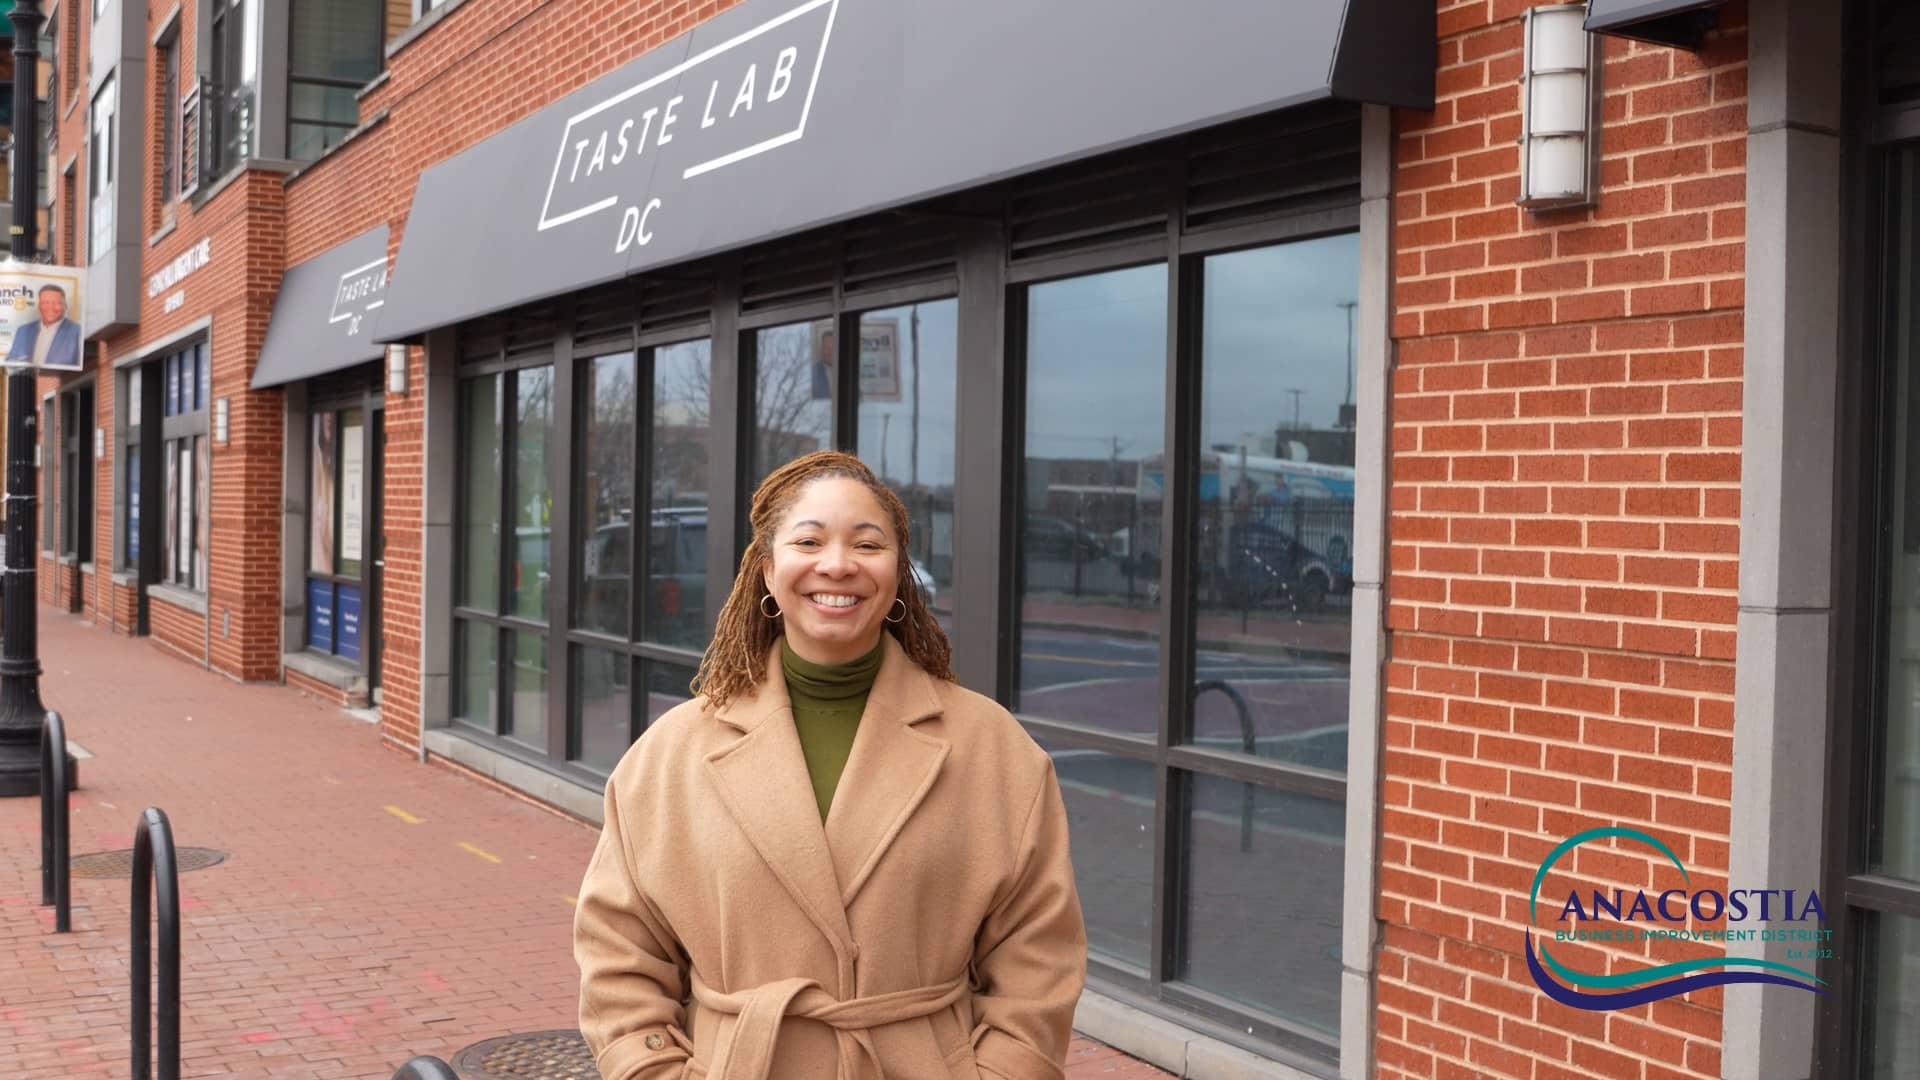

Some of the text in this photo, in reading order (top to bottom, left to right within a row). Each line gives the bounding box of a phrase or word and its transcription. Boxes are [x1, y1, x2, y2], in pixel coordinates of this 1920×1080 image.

[569, 45, 798, 183] TASTE LAB
[615, 197, 662, 253] DC
[0, 285, 34, 298] nch
[340, 269, 387, 304] TASTE LA
[347, 314, 362, 336] DC
